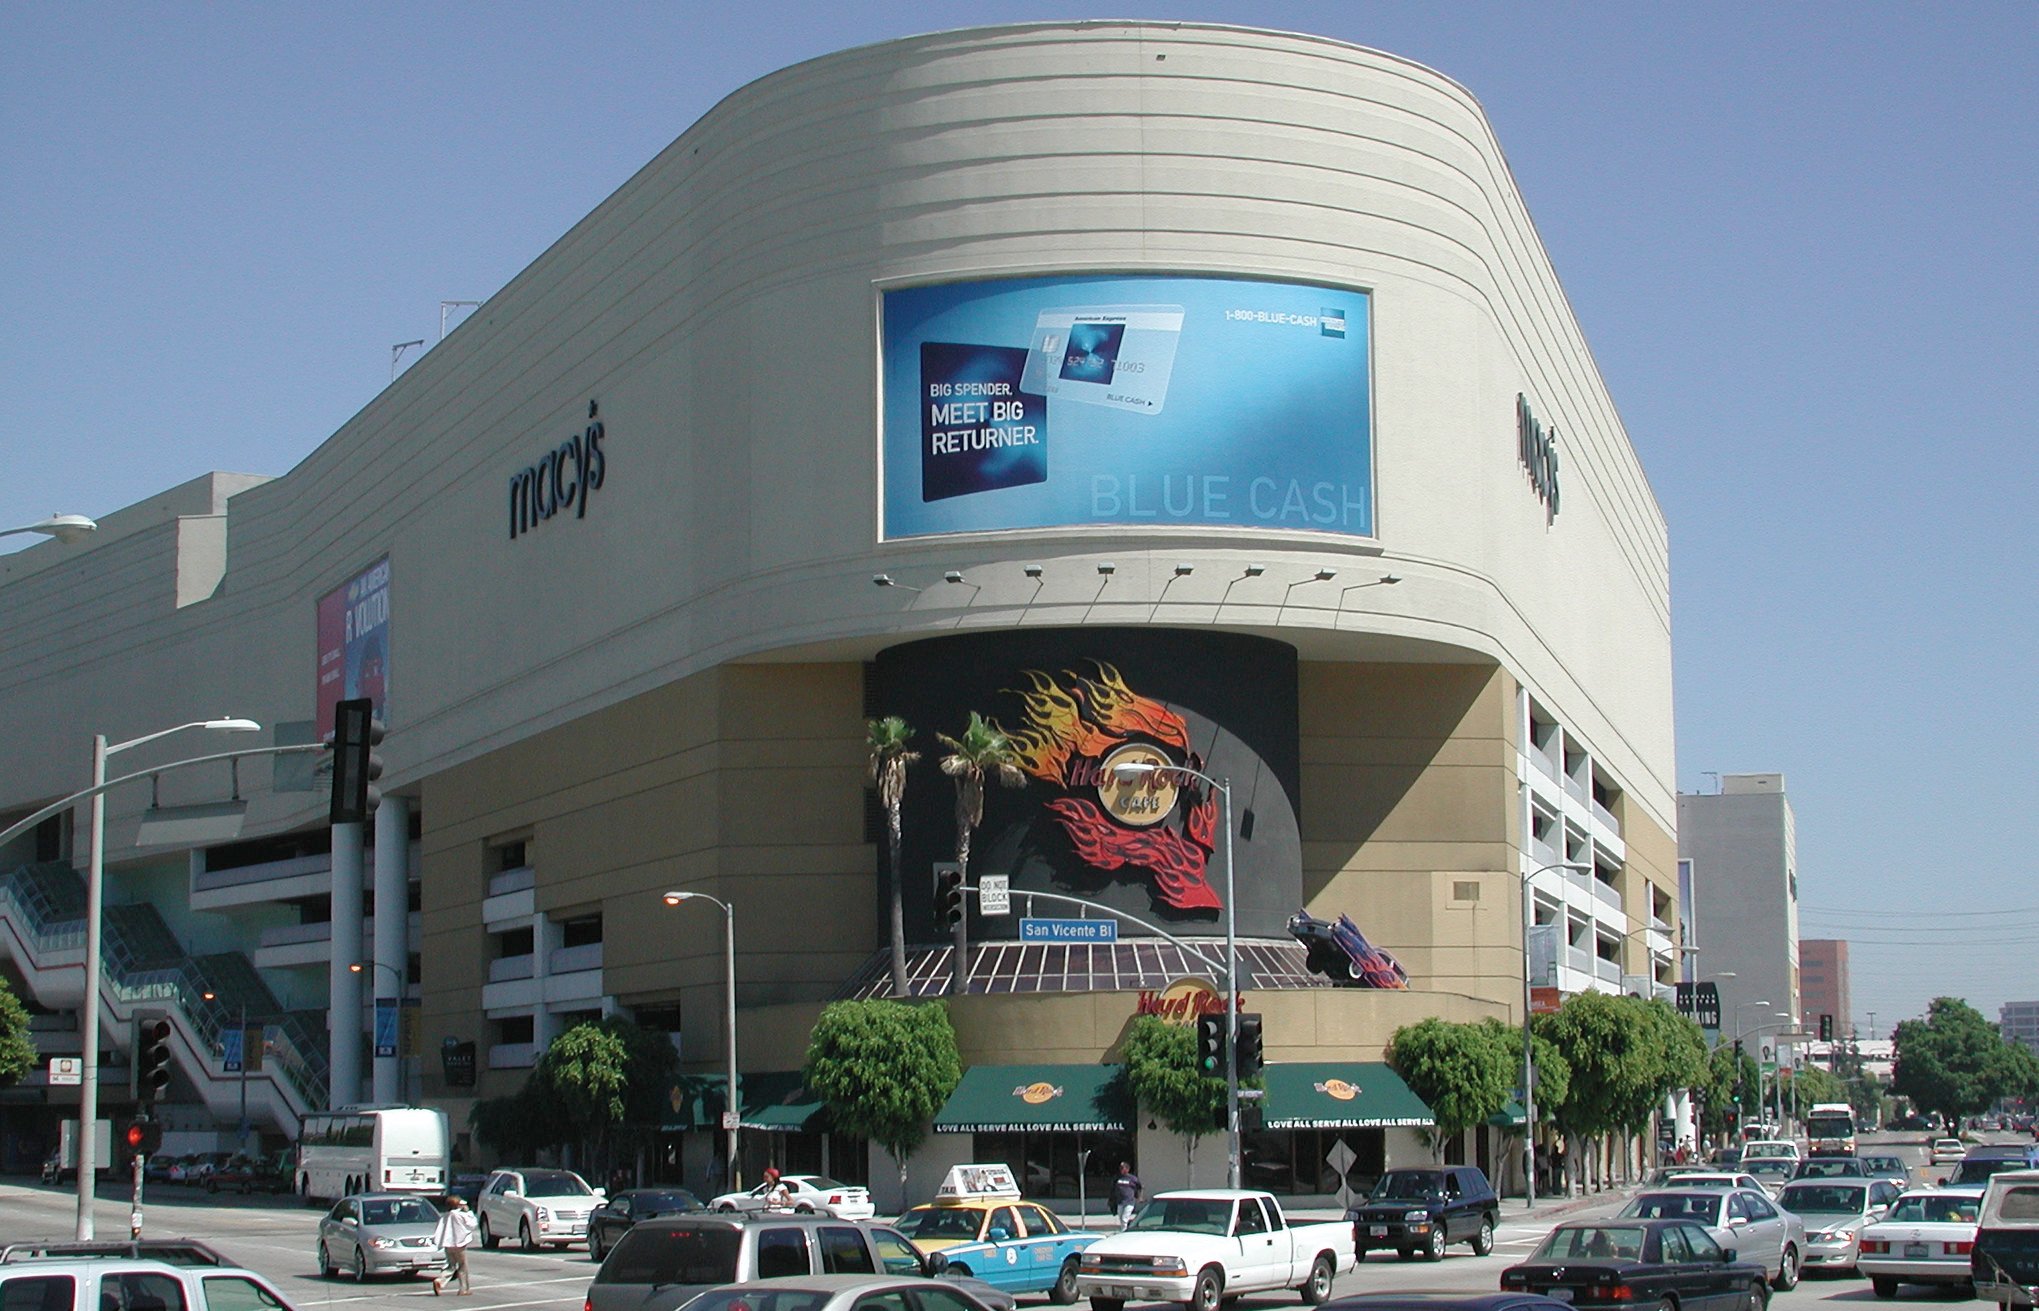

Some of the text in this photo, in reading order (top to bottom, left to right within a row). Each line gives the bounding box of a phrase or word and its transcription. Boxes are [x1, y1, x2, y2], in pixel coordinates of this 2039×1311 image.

[1225, 309, 1318, 327] 1-800-BLUE-CASH
[930, 383, 1013, 397] BIG SPENDER.
[1106, 393, 1146, 406] BLUE CASH
[931, 400, 1024, 427] MEET BIG
[931, 425, 1040, 456] RETURNER.
[509, 398, 606, 540] macy's
[1090, 474, 1366, 528] BLUE CASH
[980, 880, 1007, 890] DO NOT
[981, 892, 1008, 903] BLOCK
[1025, 923, 1112, 937] San Vicente Bl
[1137, 990, 1192, 1015] Hard
[936, 1122, 1125, 1133] LOVE ALL SERVE ALL LOVE ALL SERVE ALL
[1267, 1120, 1293, 1129] LOVE
[1293, 1119, 1311, 1128] ALL
[1312, 1119, 1342, 1128] SERVE
[1342, 1119, 1358, 1127] ALL
[1359, 1118, 1382, 1127] LOVE
[1381, 1118, 1397, 1126] ALL
[1397, 1118, 1421, 1126] SERVE
